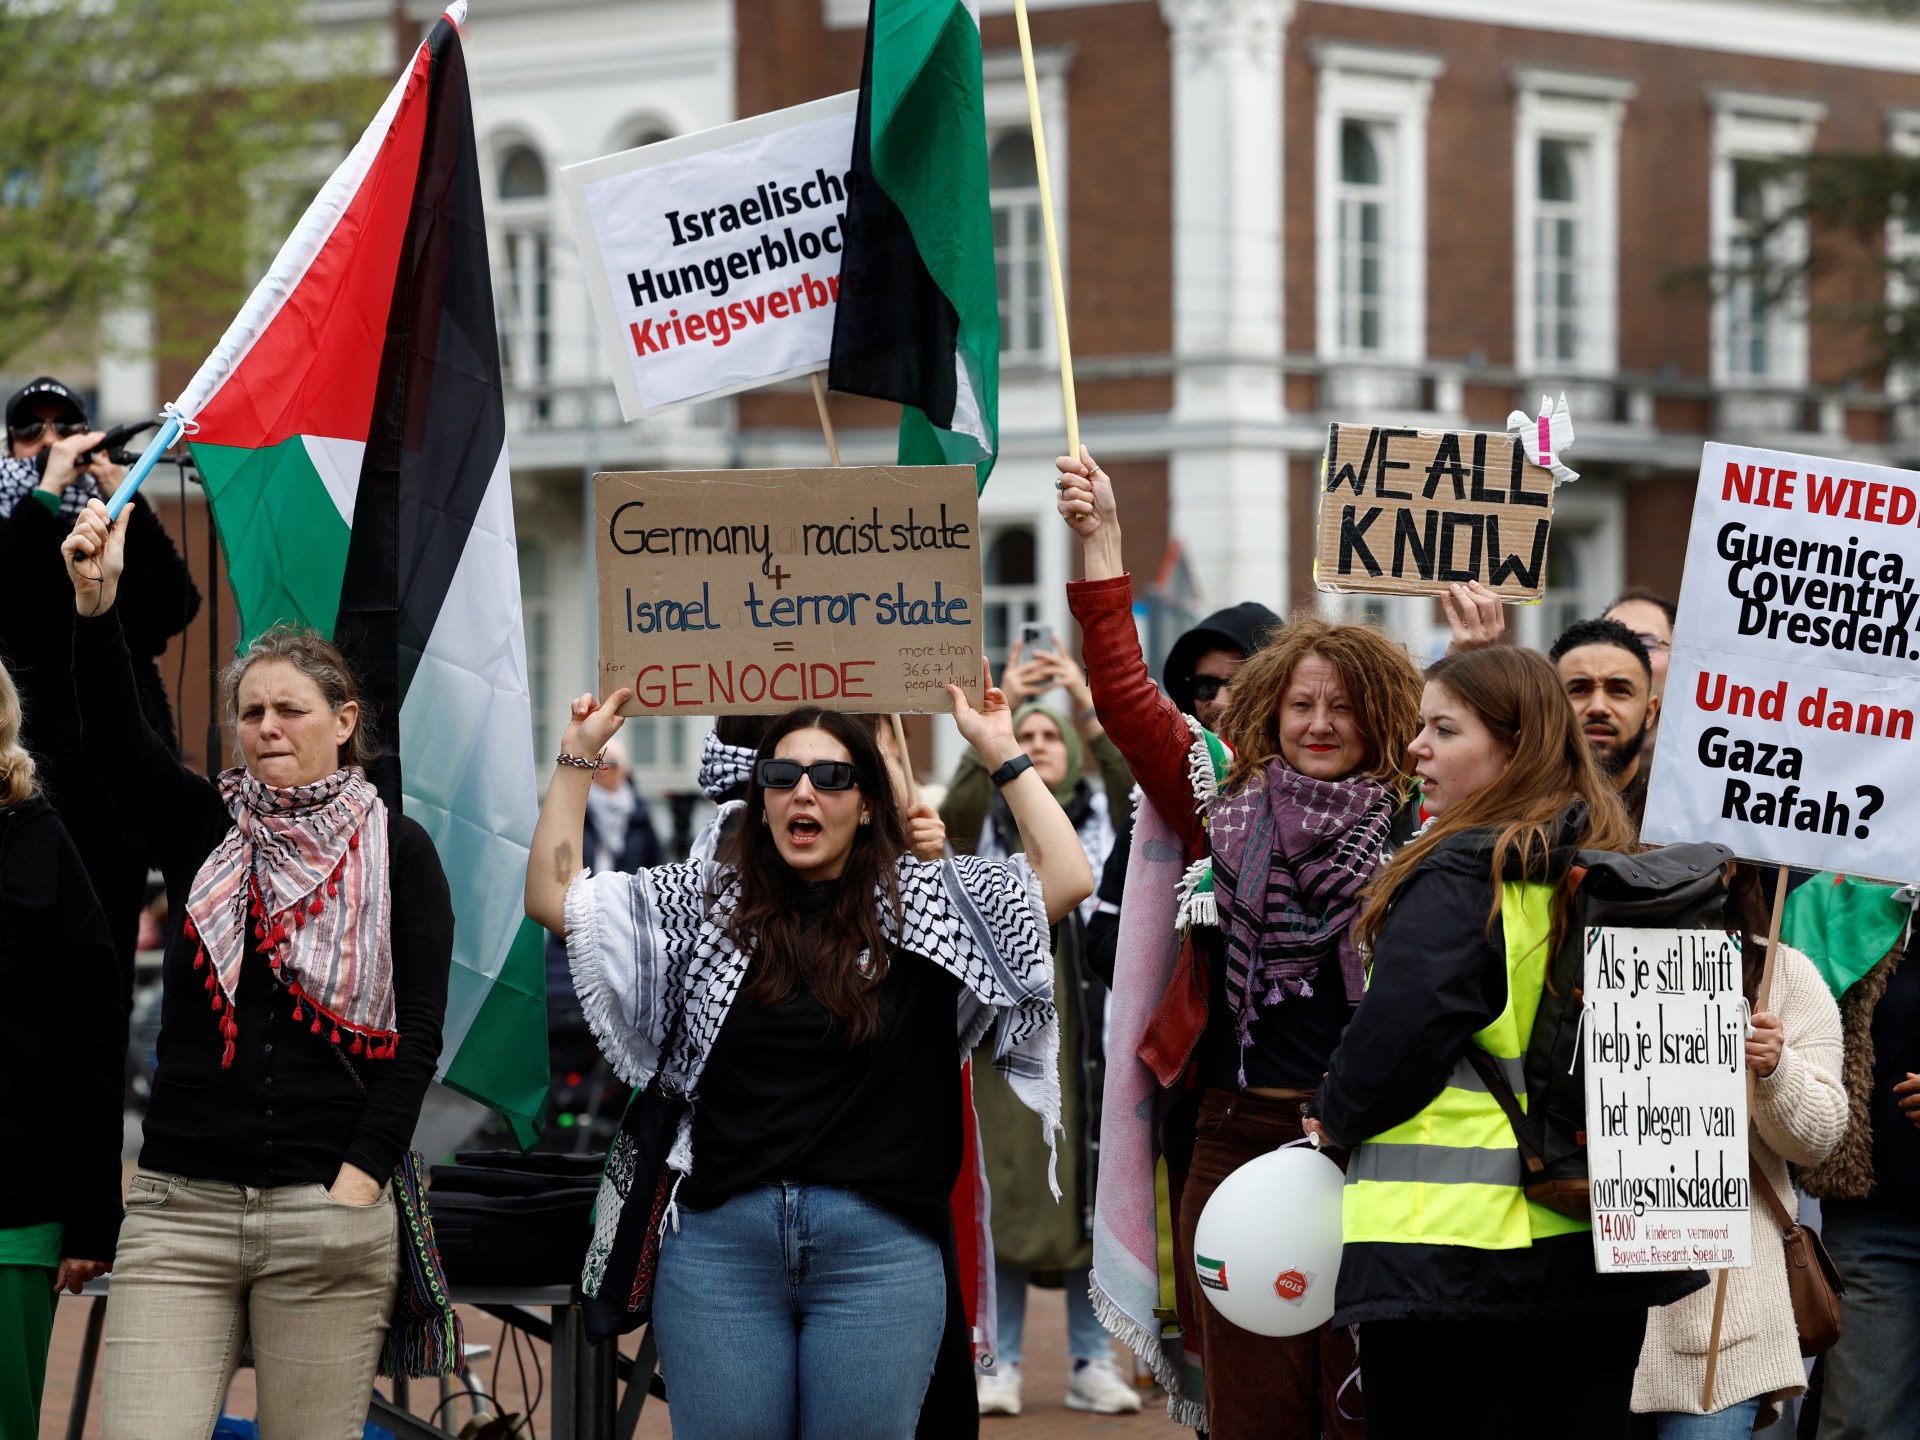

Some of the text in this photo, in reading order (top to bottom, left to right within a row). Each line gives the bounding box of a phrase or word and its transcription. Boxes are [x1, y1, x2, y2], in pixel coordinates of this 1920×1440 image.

[1327, 422, 1549, 508] WE ALL
[1721, 462, 1920, 528] NIE WIED
[609, 501, 773, 575] Germany
[802, 507, 890, 556] racist
[890, 503, 971, 551] state
[1338, 504, 1550, 589] KNOW
[1716, 522, 1915, 593] Guernica,
[626, 581, 721, 633] Israel
[744, 582, 871, 627] terror
[876, 582, 972, 627] state
[899, 642, 974, 658] more than
[604, 659, 875, 708] for GENOCIDE
[904, 678, 945, 693] people
[1695, 671, 1914, 741] Und dann
[1698, 727, 1803, 781] Gaza
[1721, 778, 1885, 840] Rafah?
[1597, 934, 1733, 1000] Als je stil blijft
[1592, 1002, 1737, 1073] help je Israël bij
[1599, 1076, 1736, 1145] het plegen van
[1593, 1149, 1749, 1217] oorlogsmisdaden
[1598, 1213, 1729, 1242] 14.000 kinderen vermoord
[1612, 1246, 1650, 1268] Boycott.
[1651, 1245, 1691, 1263] Research.
[1692, 1244, 1719, 1265] Speak
[1279, 1278, 1303, 1293] STOP
